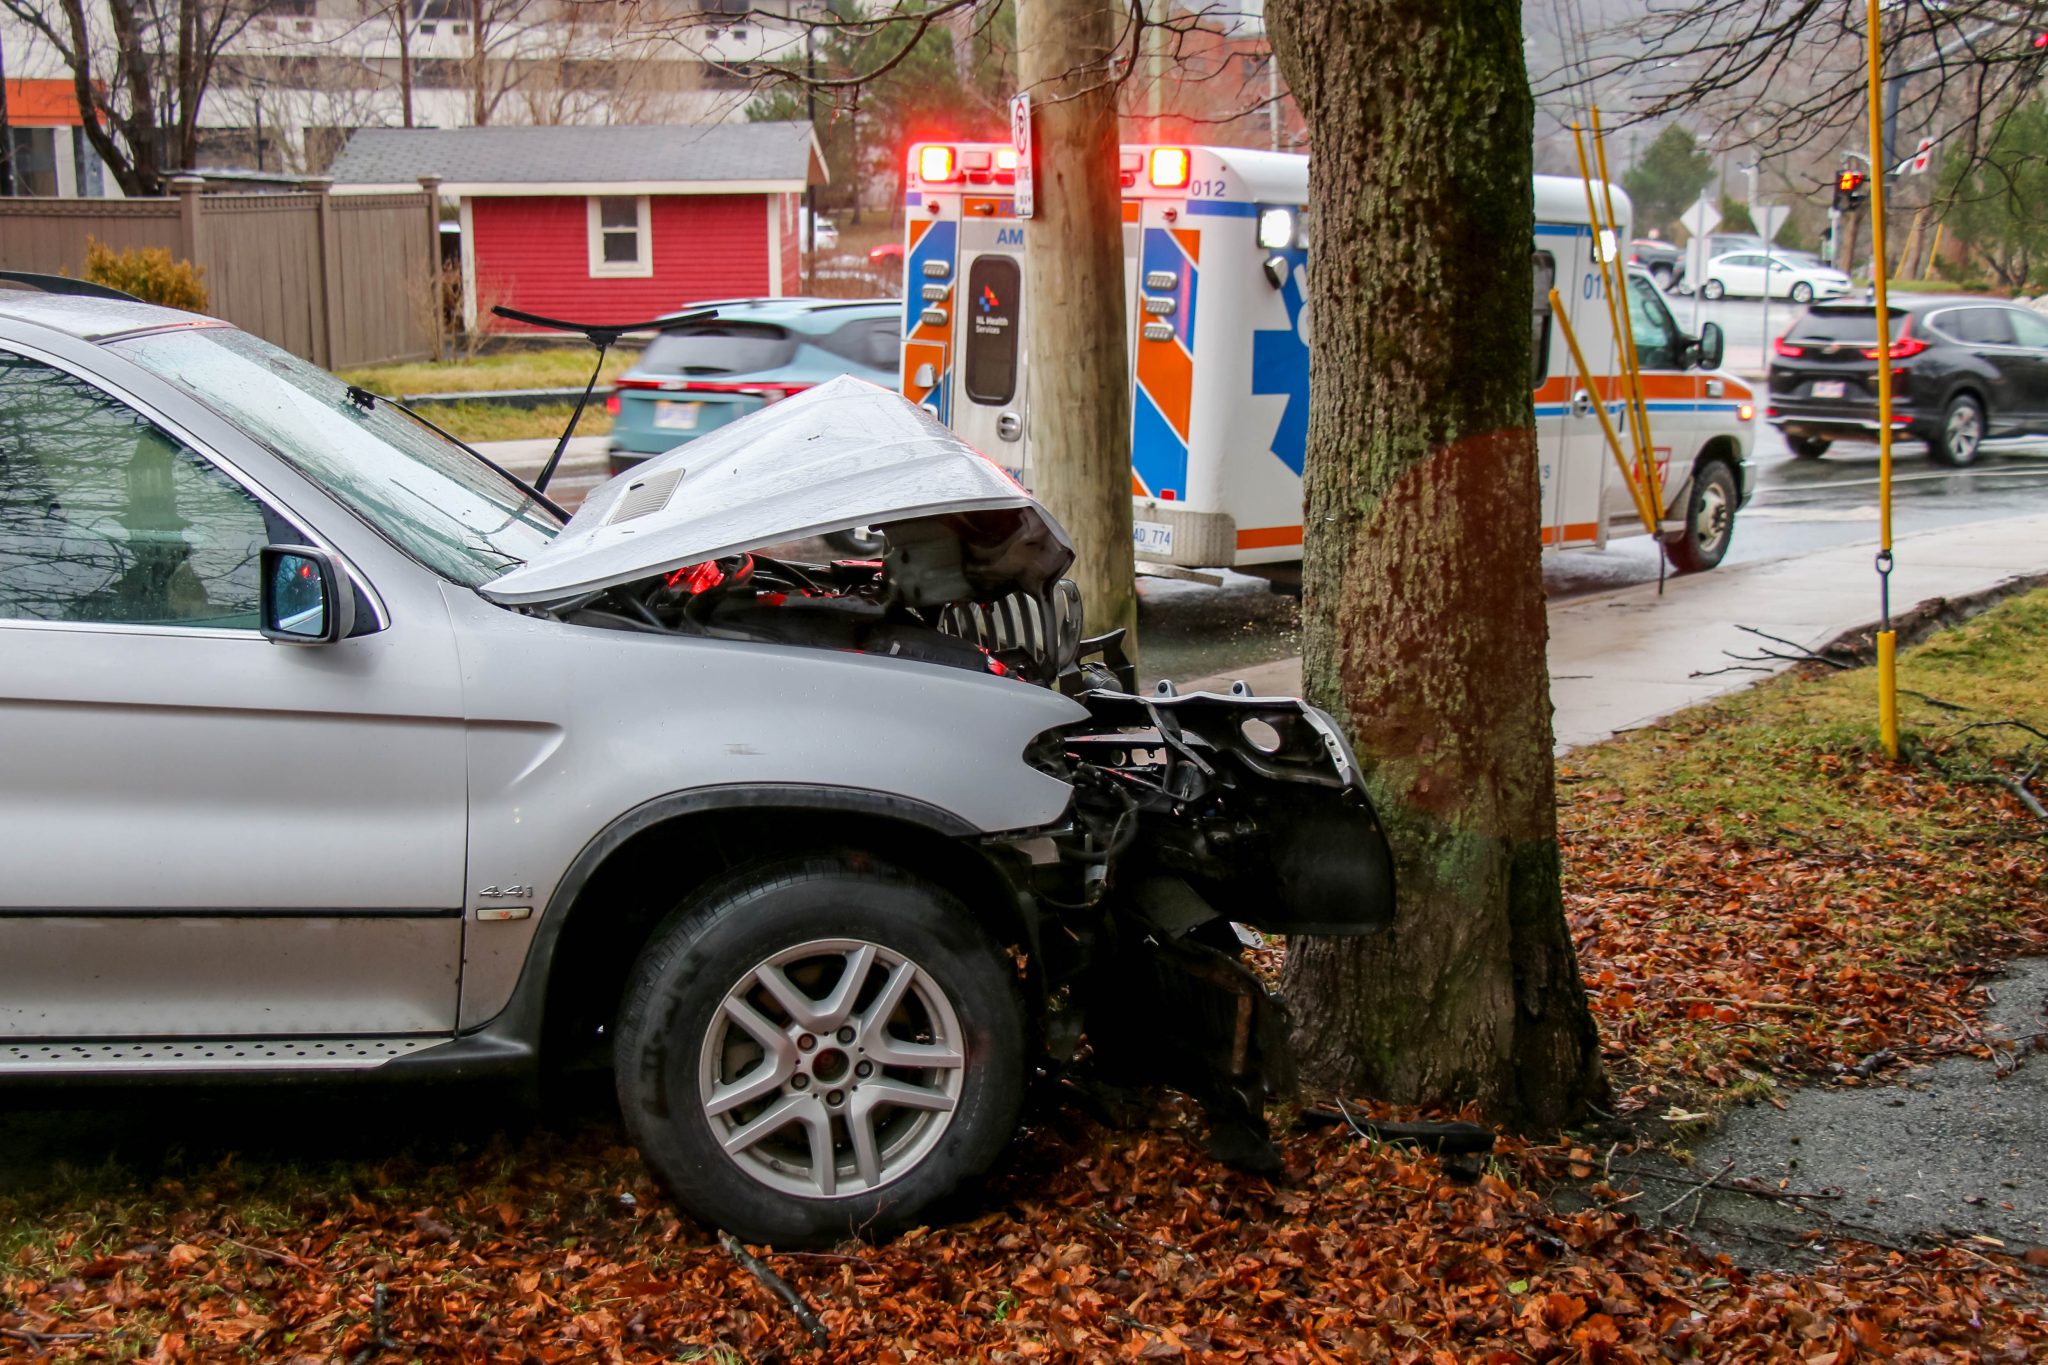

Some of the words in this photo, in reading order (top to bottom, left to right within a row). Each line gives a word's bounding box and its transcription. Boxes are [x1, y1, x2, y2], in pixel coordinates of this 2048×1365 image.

[1191, 180, 1226, 197] 012
[986, 316, 1008, 327] Health
[976, 325, 1000, 335] Services
[1152, 530, 1171, 546] 774
